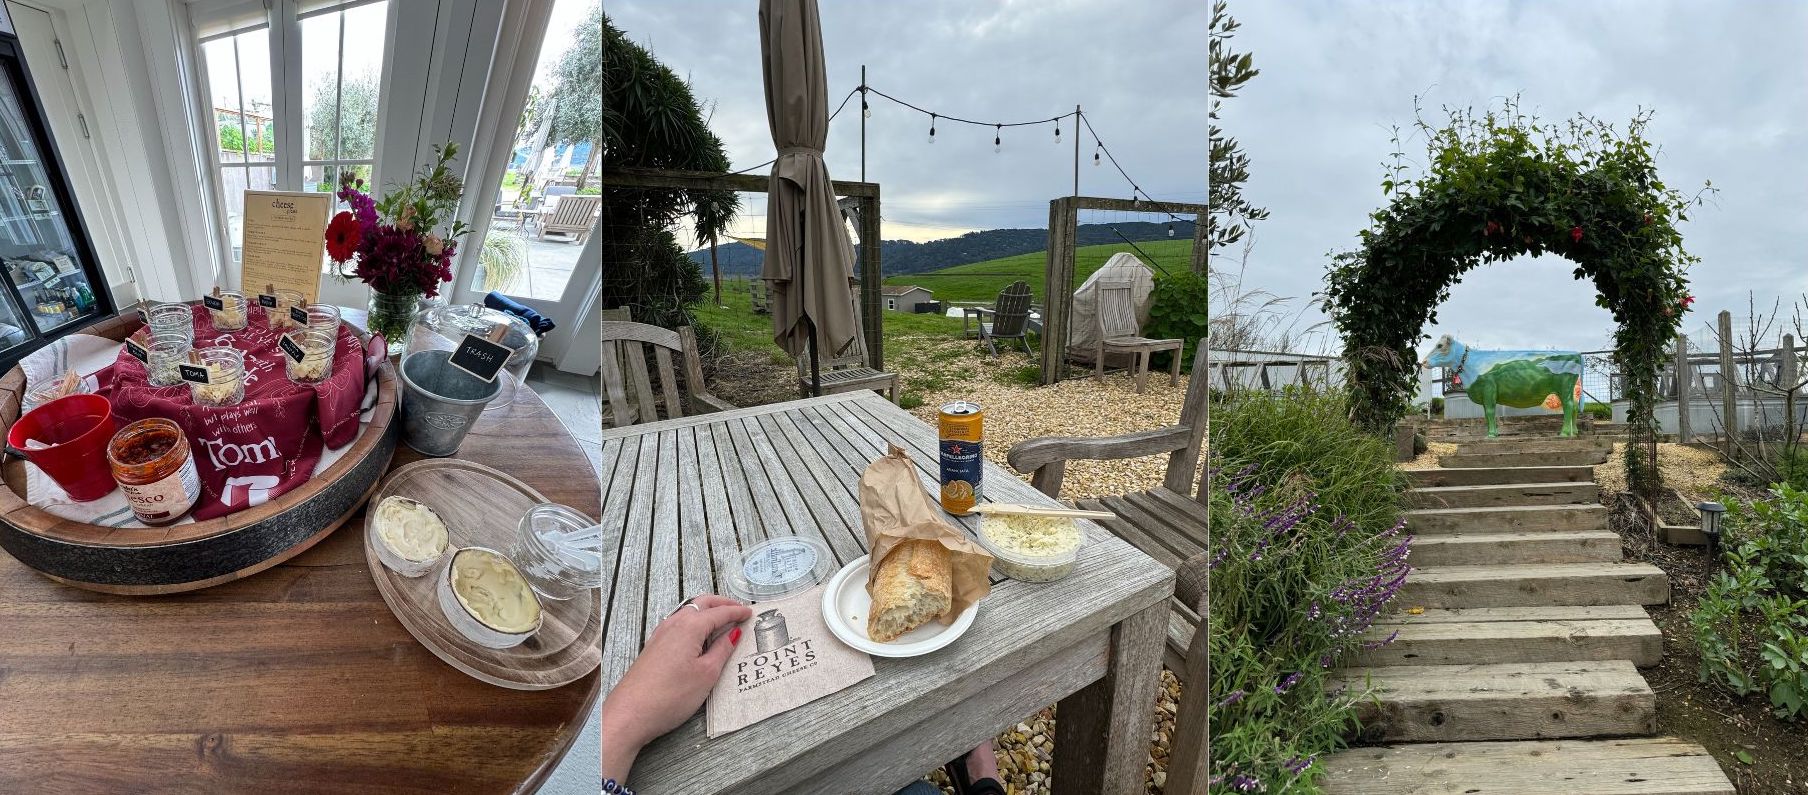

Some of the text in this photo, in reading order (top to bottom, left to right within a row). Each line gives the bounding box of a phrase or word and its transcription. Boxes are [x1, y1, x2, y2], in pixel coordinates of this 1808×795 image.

[466, 346, 494, 363] TRASH
[185, 369, 205, 378] TOMA
[204, 413, 218, 426] but
[220, 410, 241, 422] plays
[212, 424, 231, 437] with
[737, 639, 812, 673] POINT
[737, 650, 816, 686] REYES
[738, 675, 780, 693] FARMSTEAD
[782, 665, 807, 678] CHEESE
